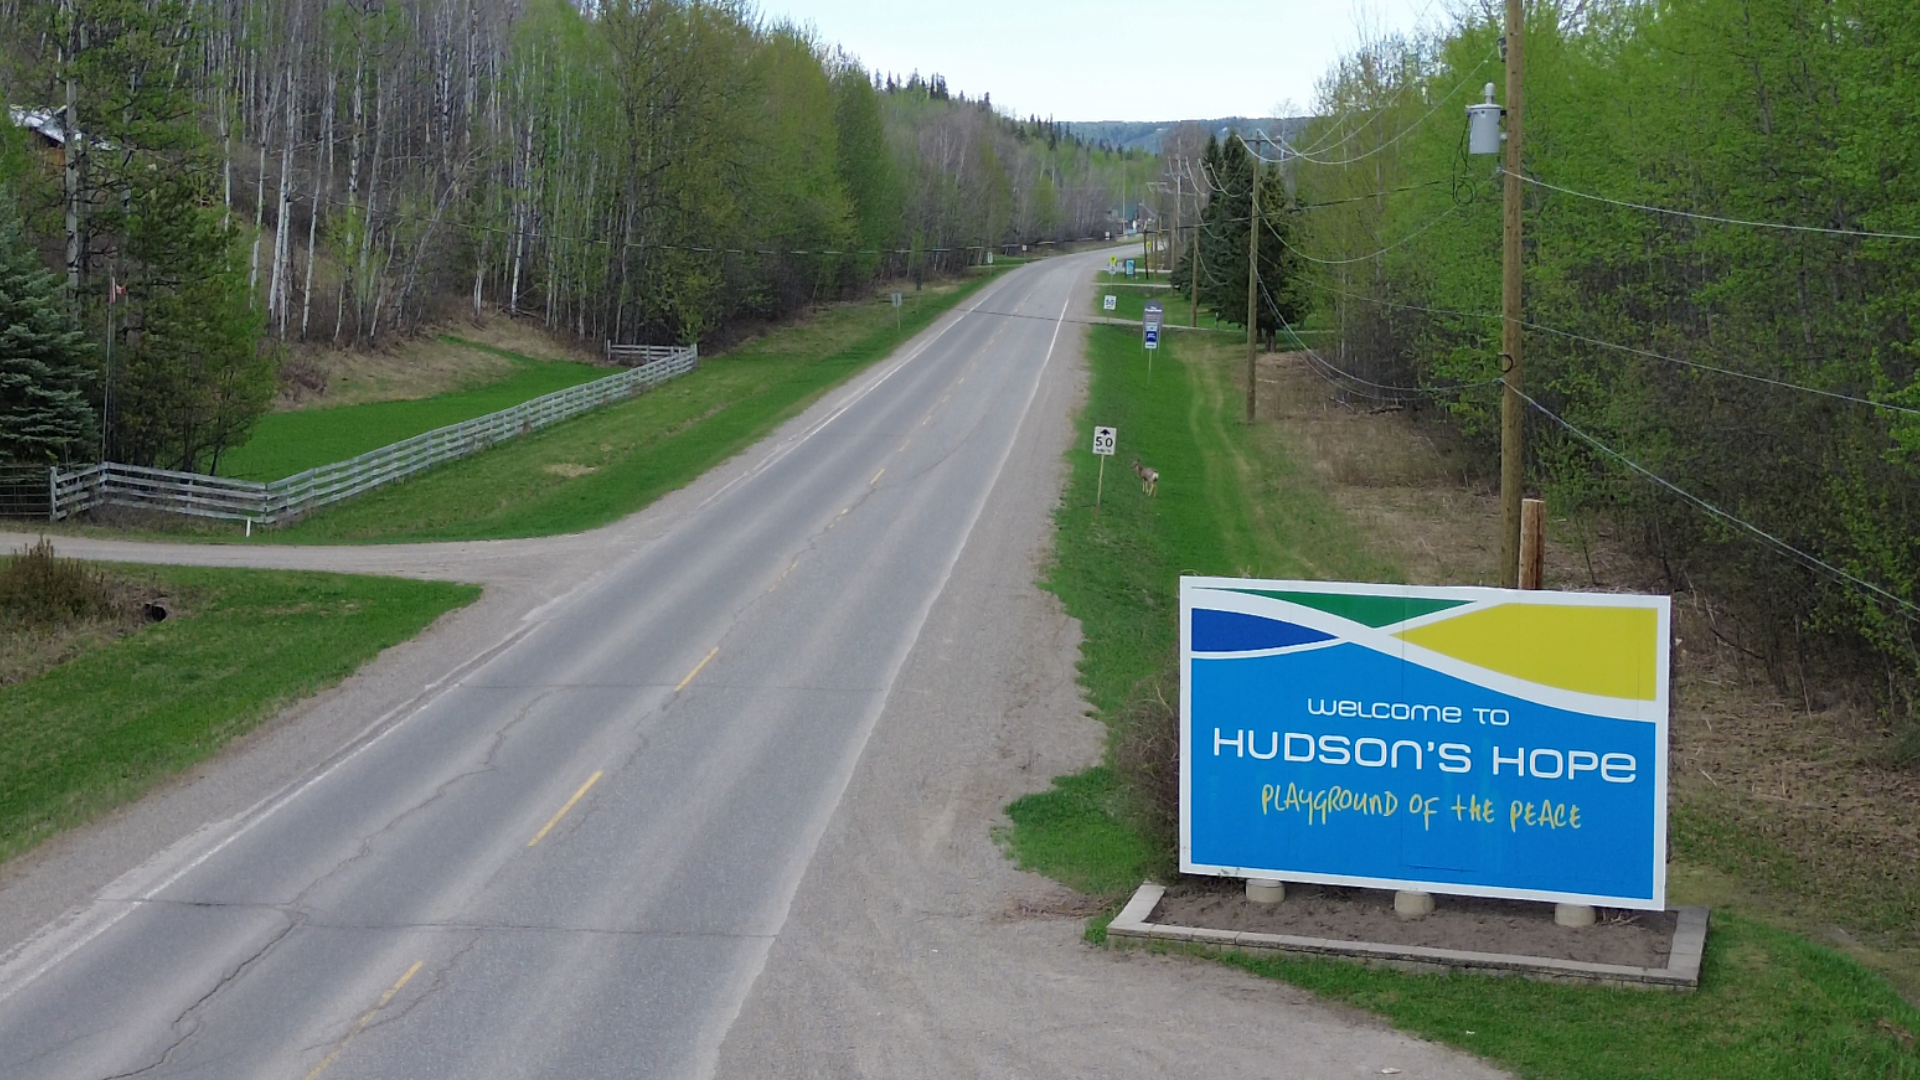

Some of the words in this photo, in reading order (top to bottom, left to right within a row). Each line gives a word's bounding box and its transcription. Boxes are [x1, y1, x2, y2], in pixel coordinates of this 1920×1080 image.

[1095, 436, 1113, 447] 50
[1473, 708, 1509, 725] TO
[1493, 746, 1636, 783] HOPE
[1262, 783, 1397, 825] PLAYGROUND
[1410, 794, 1439, 831] OF
[1510, 800, 1580, 832] PEACE
